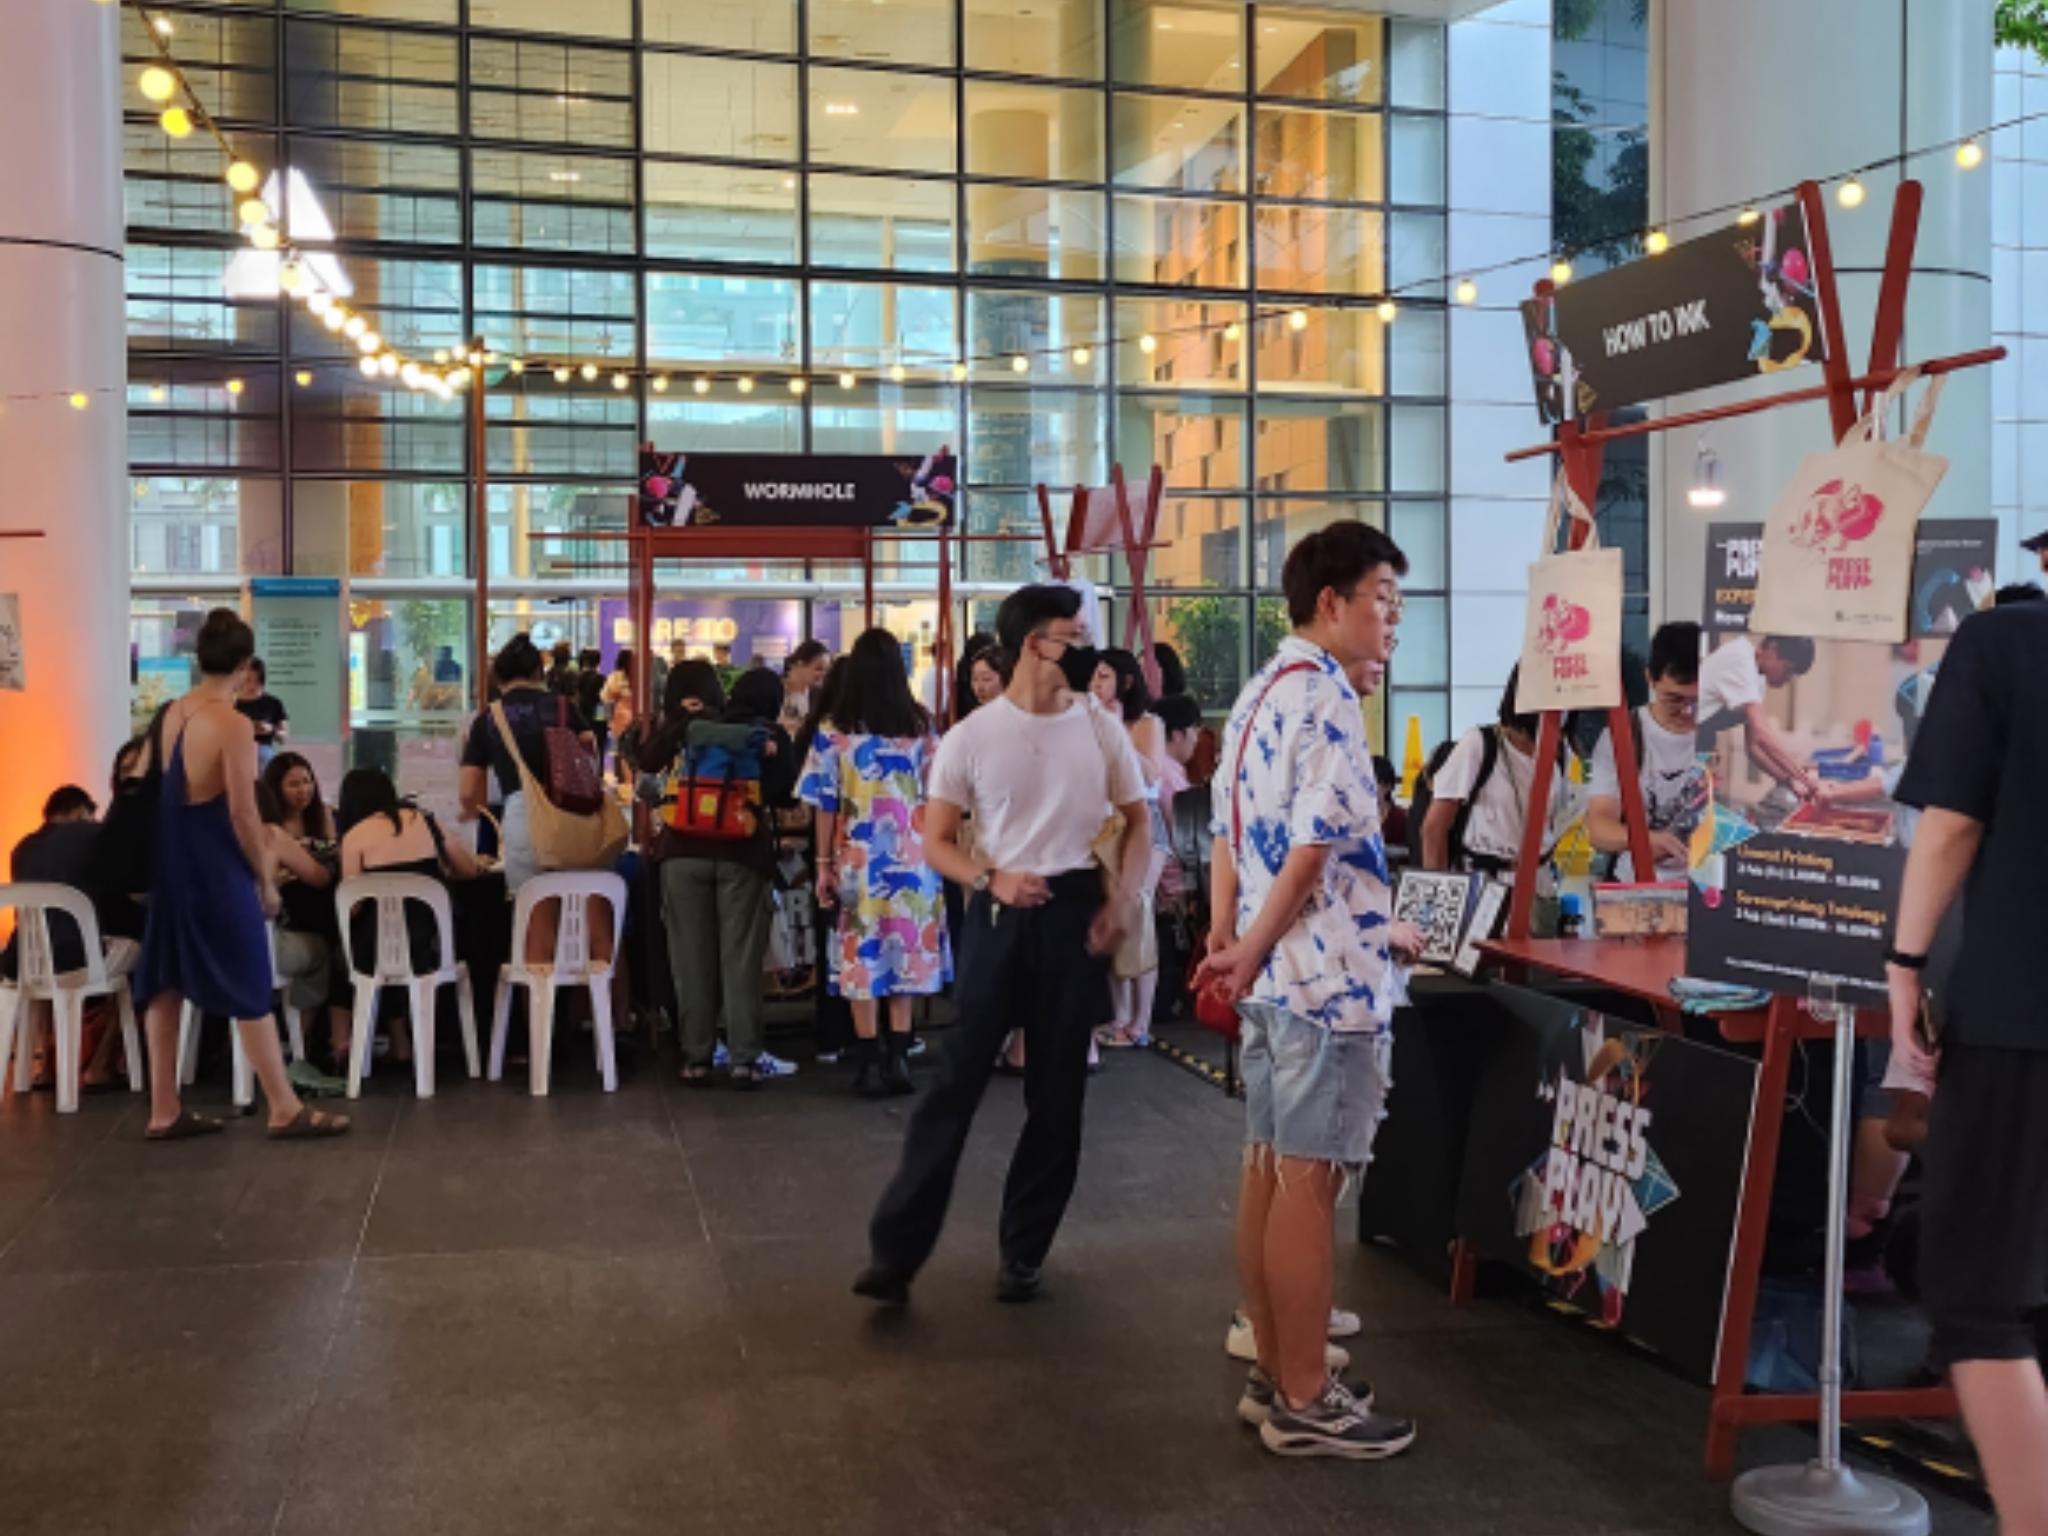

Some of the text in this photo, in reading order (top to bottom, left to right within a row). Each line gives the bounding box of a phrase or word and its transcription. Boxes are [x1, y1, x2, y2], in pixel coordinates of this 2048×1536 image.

[1602, 298, 1711, 357] HOW TO INK
[744, 482, 856, 500] WORMHOLE
[1828, 557, 1872, 574] PRESS
[1552, 1079, 1652, 1181] PRESS
[1542, 1146, 1634, 1246] PLAY
